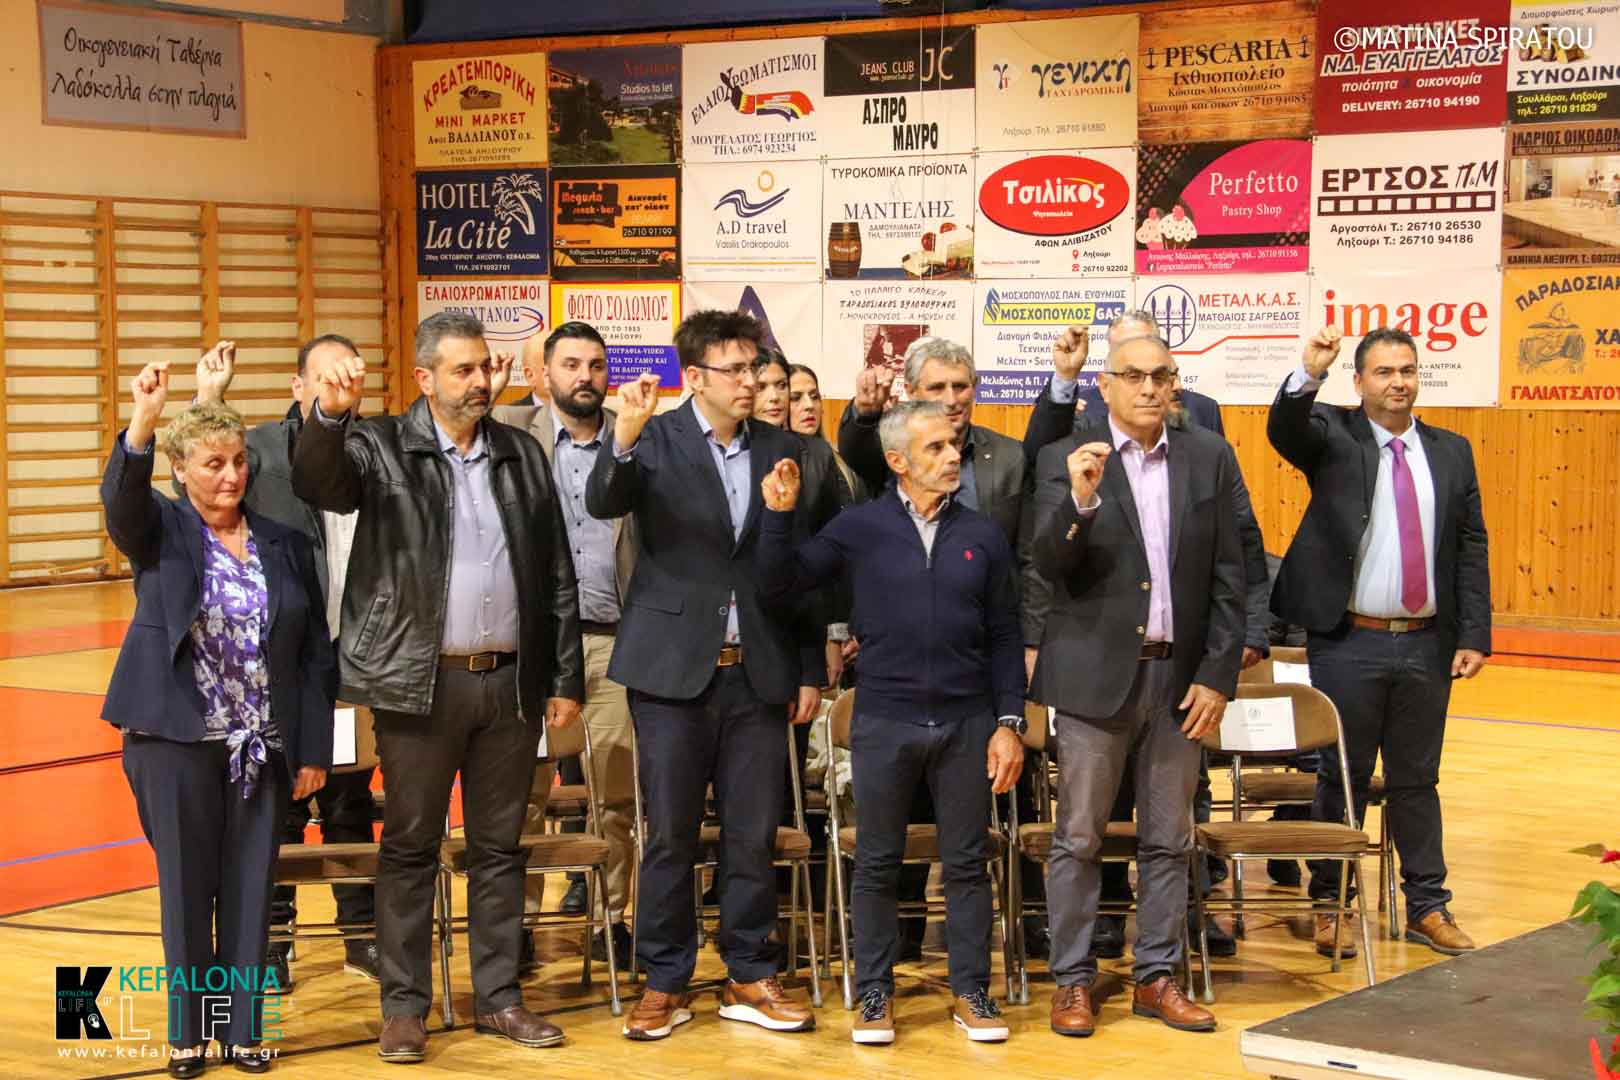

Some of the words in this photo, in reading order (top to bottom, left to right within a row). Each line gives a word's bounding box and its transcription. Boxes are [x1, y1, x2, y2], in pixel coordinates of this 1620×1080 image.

[1521, 8, 1584, 19] Διαμορφώσεις
[64, 27, 160, 67] Οικογενειακή
[167, 36, 222, 76] Ταβέρνα
[1164, 38, 1292, 67] PESCARIA
[921, 47, 953, 81] JC
[1320, 54, 1360, 77] Ν.Δ.
[1362, 43, 1504, 74] ΕΥΑΓΓΕΛΑΤΟΣ
[860, 62, 887, 75] JEANS
[893, 61, 914, 73] CLUB
[1173, 63, 1285, 86] Ιχθυοπωλείο
[1516, 64, 1620, 85] ΣΥΝΟΔΙΝ
[52, 67, 140, 102] Λαδόκολλα
[424, 60, 535, 112] ΚΡΕΑΤΕΜΠΟΡΙΚΗ
[621, 83, 649, 94] Studios
[652, 84, 660, 93] to
[662, 82, 673, 92] let
[690, 54, 817, 126] ΕΛΑΙΟΧΡΩΜΑΤΙΣΜΟΙ
[1342, 78, 1398, 93] ποιότητα
[1416, 72, 1482, 88] οικονομία
[1570, 91, 1607, 101] Ληξούρι
[862, 96, 907, 124] ΑΣΠΡΟ
[1342, 101, 1403, 113] DELIVERY:
[1405, 97, 1440, 110] 26710
[1444, 95, 1480, 107] 94190
[1540, 105, 1568, 114] 26710
[472, 112, 526, 126] ΜΑΡΚΕΤ
[448, 129, 516, 143] ΒΑΛΛΙΑΝΟΥ
[691, 135, 761, 145] ΜΟΥΡΕΛΑΤΟΣ
[764, 131, 816, 142] ΓΕΩΡΓΙΟΣ
[893, 122, 938, 151] ΜΑΥΡΟ
[743, 144, 762, 154] 6974
[832, 166, 905, 178] ΤΥΡΟΚΟΜΙΚΑ
[909, 163, 968, 176] ΠΡΟΪΟΝΤΑ
[1208, 169, 1298, 196] Perfetto
[1322, 165, 1449, 192] ΕΡΤΣΟΣ
[422, 183, 490, 209] HOTEL
[1003, 177, 1105, 208] Τσιλίκος
[844, 200, 955, 220] ΜΑΝΤΕΛΗΣ
[1222, 205, 1253, 218] Pastry
[1256, 204, 1282, 217] Shop
[425, 220, 454, 249] La
[458, 217, 513, 249] Cité
[624, 228, 646, 236] 26710
[717, 221, 740, 234] A.D
[747, 220, 787, 234] travel
[1330, 223, 1387, 235] Αργοστόλι
[1390, 222, 1403, 231] Τ.:
[1407, 222, 1442, 231] 26710
[1445, 220, 1482, 230] 26530
[1034, 239, 1060, 247] ΑΦΩΝ
[1062, 224, 1113, 246] ΑΛΙΒΙΖΑΤΟΥ
[1337, 238, 1379, 248] Ληξούρι
[1383, 237, 1396, 246] Τ.:
[1400, 235, 1434, 245] 26710
[1438, 234, 1474, 244] 94186
[716, 240, 739, 248] Vasilis
[742, 240, 789, 251] Drakopoulos
[425, 286, 541, 301] ΕΛΑΙΟΧΡΩΜΑΤΙΣΜΟΙ
[1002, 291, 1061, 300] ΜΟΣΧΟΠΟΥΛΟΣ
[568, 295, 602, 320] ΦΩΤΟ
[607, 296, 668, 321] ΣΟΛΩΜΟΣ
[1001, 308, 1091, 320] ΜΟΣΧΟΠΟΥΛΟΣ
[1096, 307, 1122, 320] GAS
[1198, 312, 1247, 322] ΜΑΤΘΑΙΟΣ
[1249, 311, 1300, 320] ΣΑΓΡΕΔΟΣ
[1324, 289, 1488, 352] image
[997, 331, 1030, 341] Διανομή
[1033, 331, 1061, 341] Φιαλώ
[1019, 344, 1051, 353] Τεχνική
[997, 357, 1026, 365] Μελέτη
[1034, 357, 1056, 365] Serv
[981, 376, 1024, 386] Μελιδώνης
[1025, 376, 1031, 385] &
[1000, 389, 1023, 398] 26710
